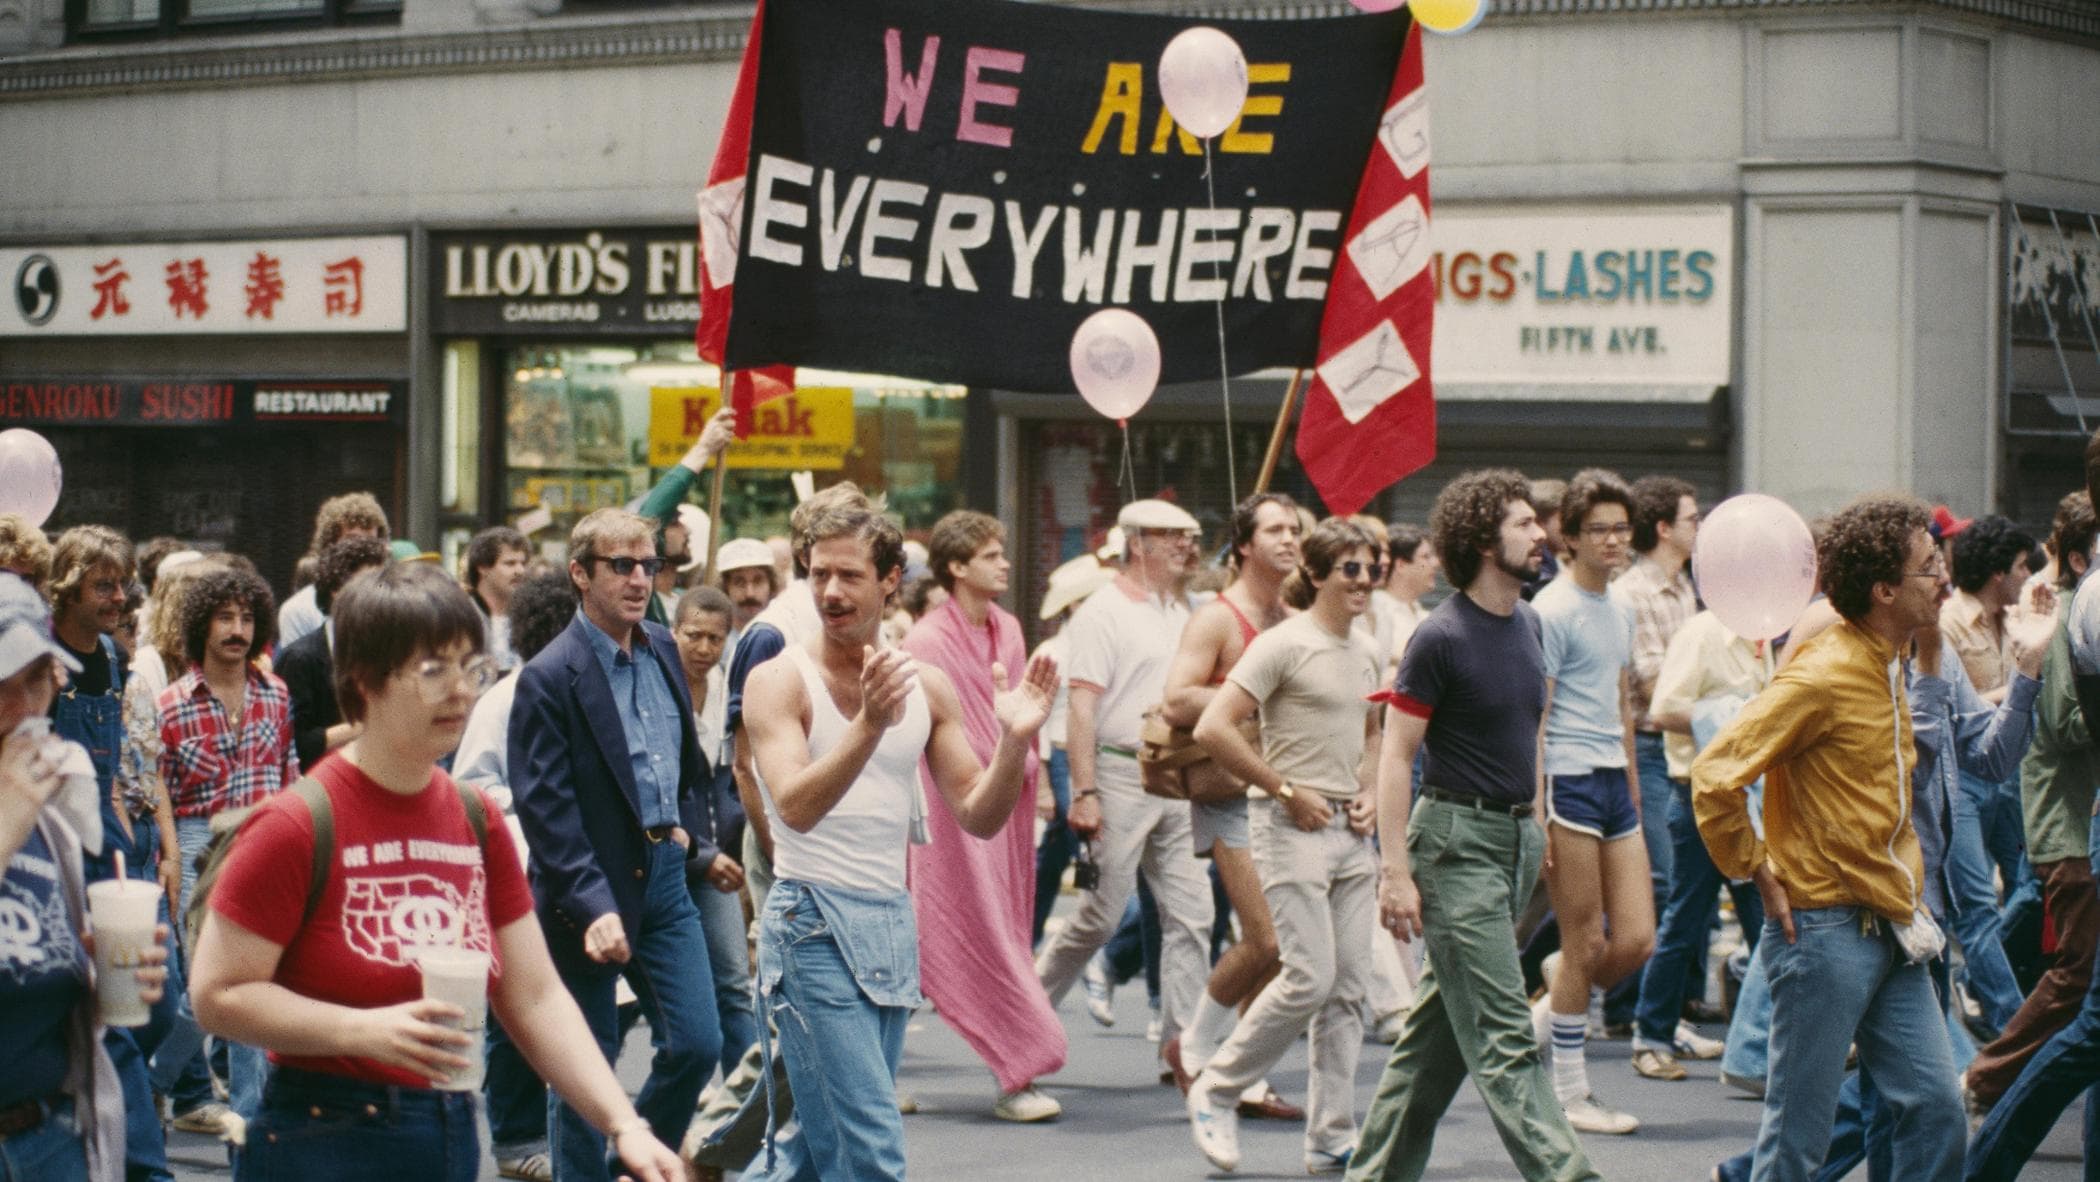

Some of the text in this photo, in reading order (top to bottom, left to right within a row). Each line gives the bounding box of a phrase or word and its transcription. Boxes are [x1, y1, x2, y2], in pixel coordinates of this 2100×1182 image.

[883, 27, 1026, 148] WE
[749, 154, 1342, 303] EVERYWHERE
[446, 232, 701, 296] LLOYD'S FI
[503, 302, 600, 322] CAMERAS
[1520, 326, 1668, 352] FIFTH AVE.
[140, 384, 235, 420] SUSHI
[254, 391, 391, 413] RESTAURANT
[683, 396, 815, 437] Kak
[343, 845, 368, 867] WE
[374, 840, 404, 864] ARE
